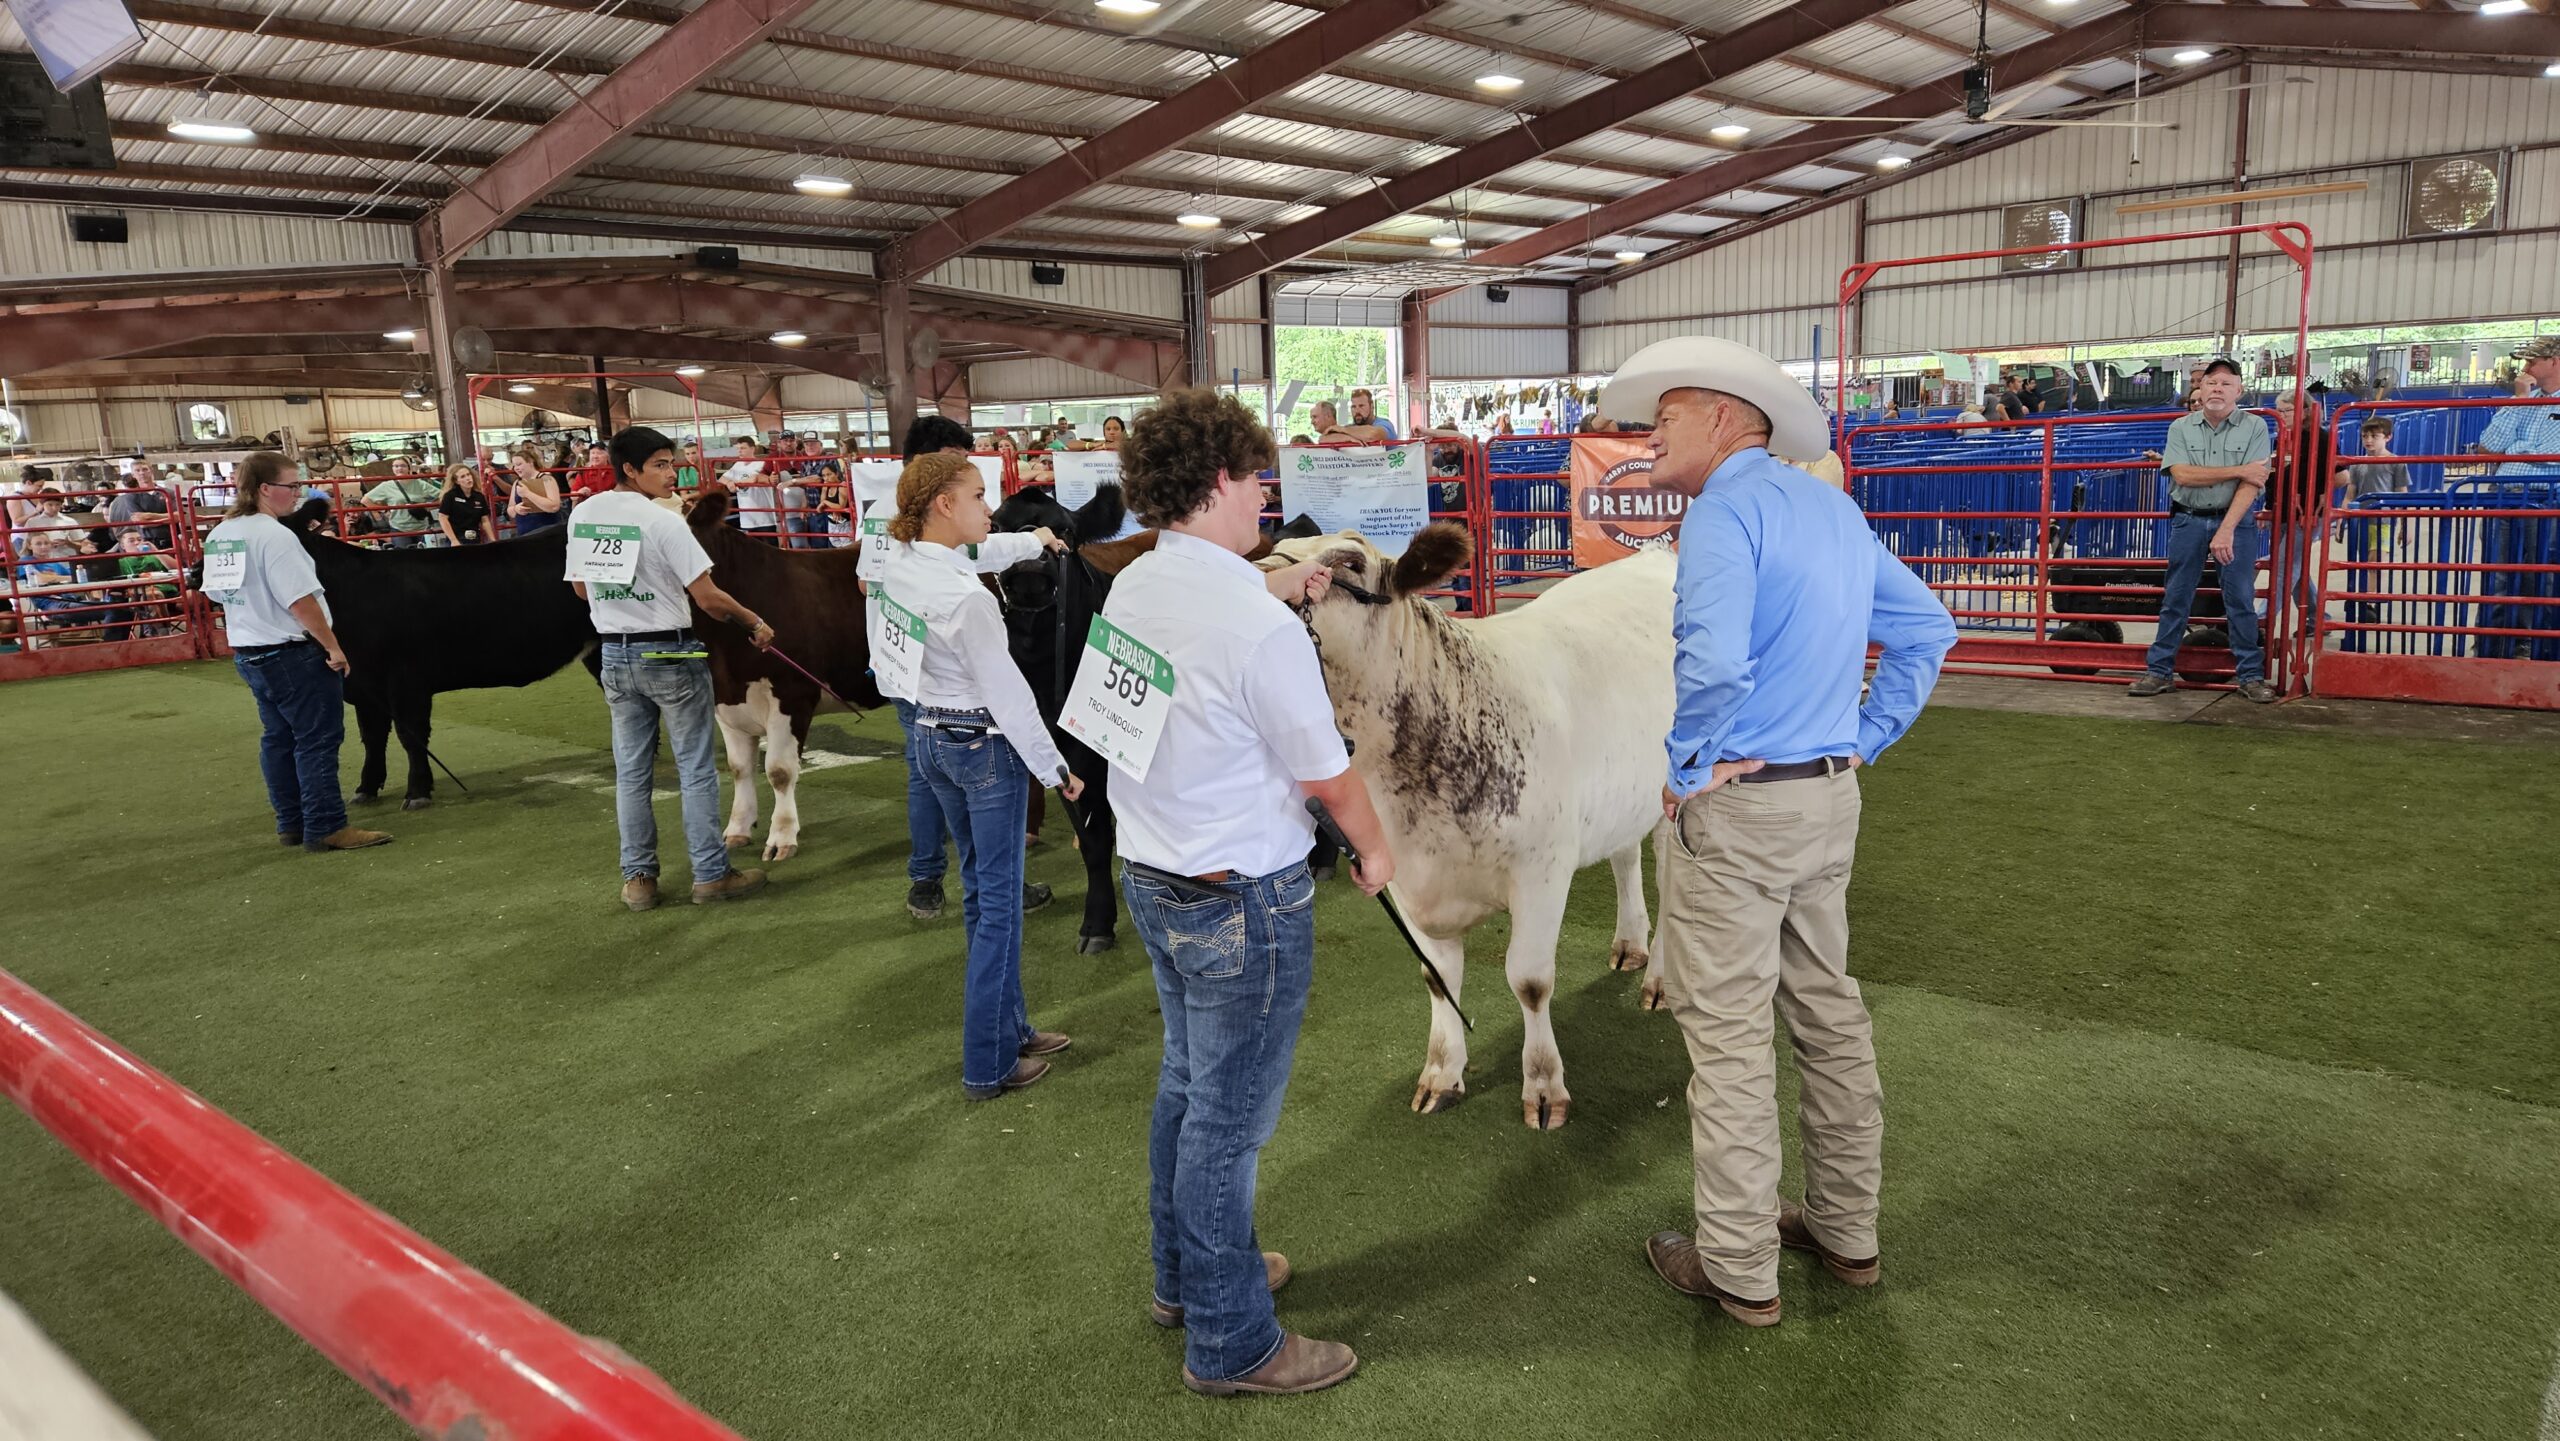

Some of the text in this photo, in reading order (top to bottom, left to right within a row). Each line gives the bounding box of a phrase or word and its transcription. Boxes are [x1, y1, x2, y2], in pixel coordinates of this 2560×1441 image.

[1604, 461, 1654, 483] SARPY COUN
[216, 552, 236, 567] 531
[591, 538, 623, 555] 728
[882, 598, 912, 633] NEBRASKA
[885, 618, 906, 654] 631
[1106, 629, 1156, 680] NEBRASKA
[1103, 657, 1148, 708] 569
[1087, 696, 1107, 716] TROY
[1106, 708, 1143, 740] LINDQUIST
